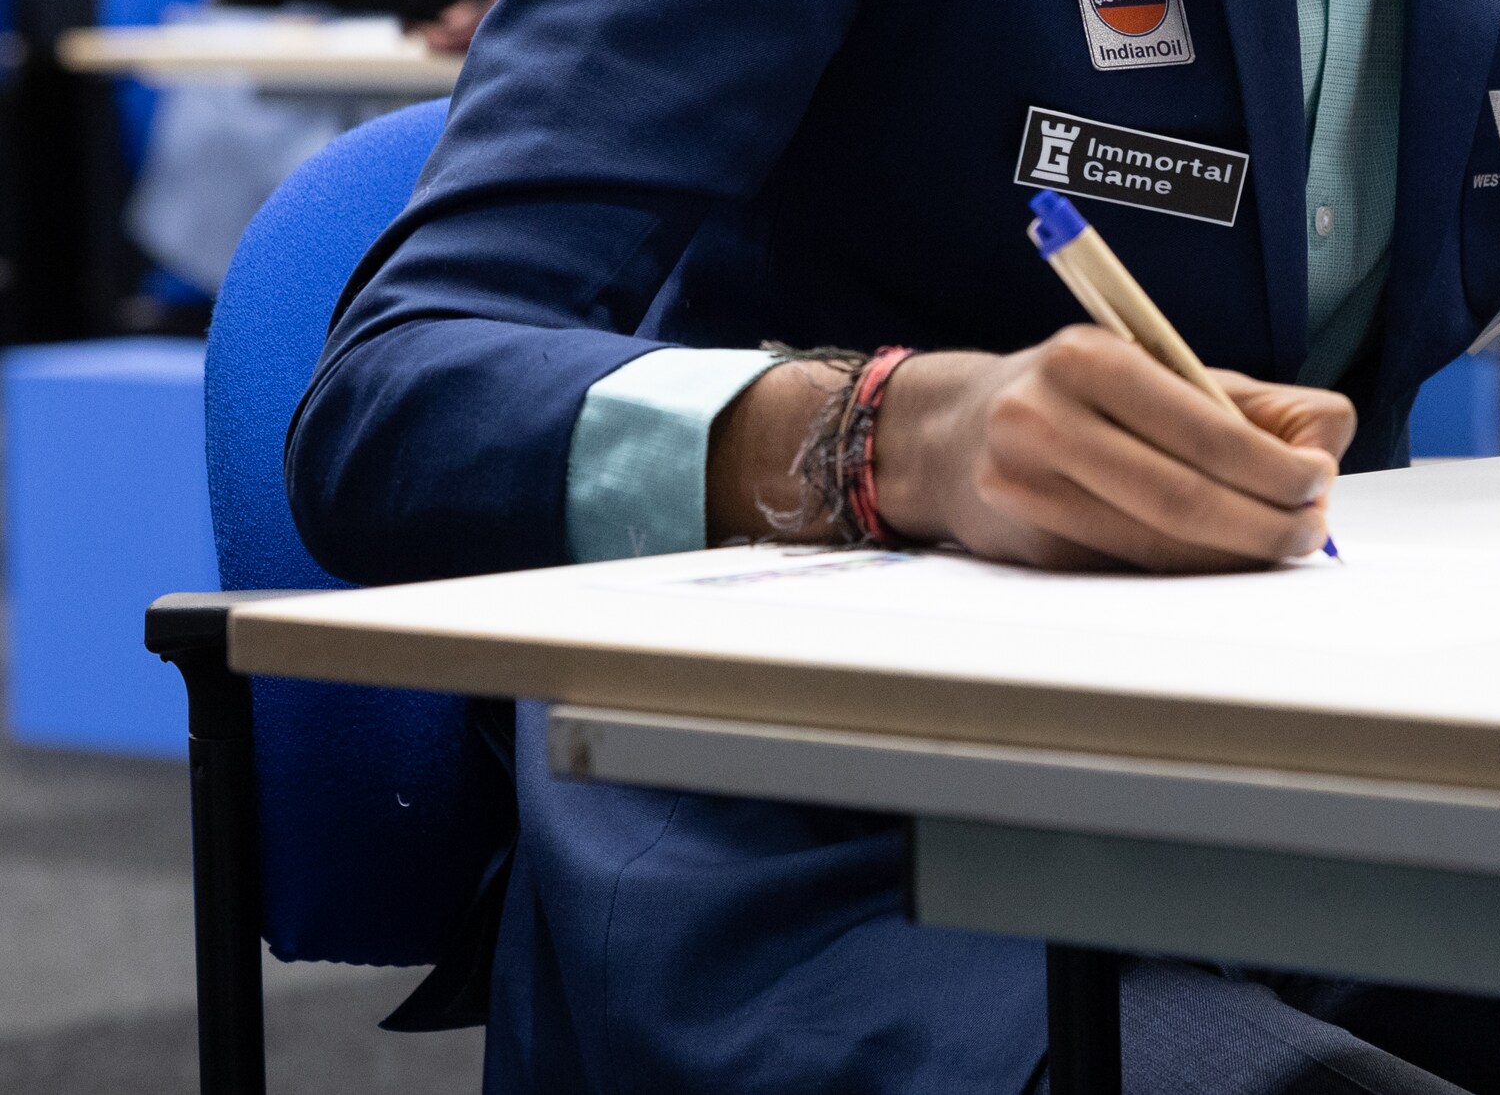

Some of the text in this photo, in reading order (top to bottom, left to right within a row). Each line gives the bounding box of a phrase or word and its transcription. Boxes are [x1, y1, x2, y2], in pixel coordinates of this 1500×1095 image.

[1100, 40, 1183, 60] IndianOil
[1087, 137, 1232, 183] Immortal
[1083, 161, 1172, 195] Game
